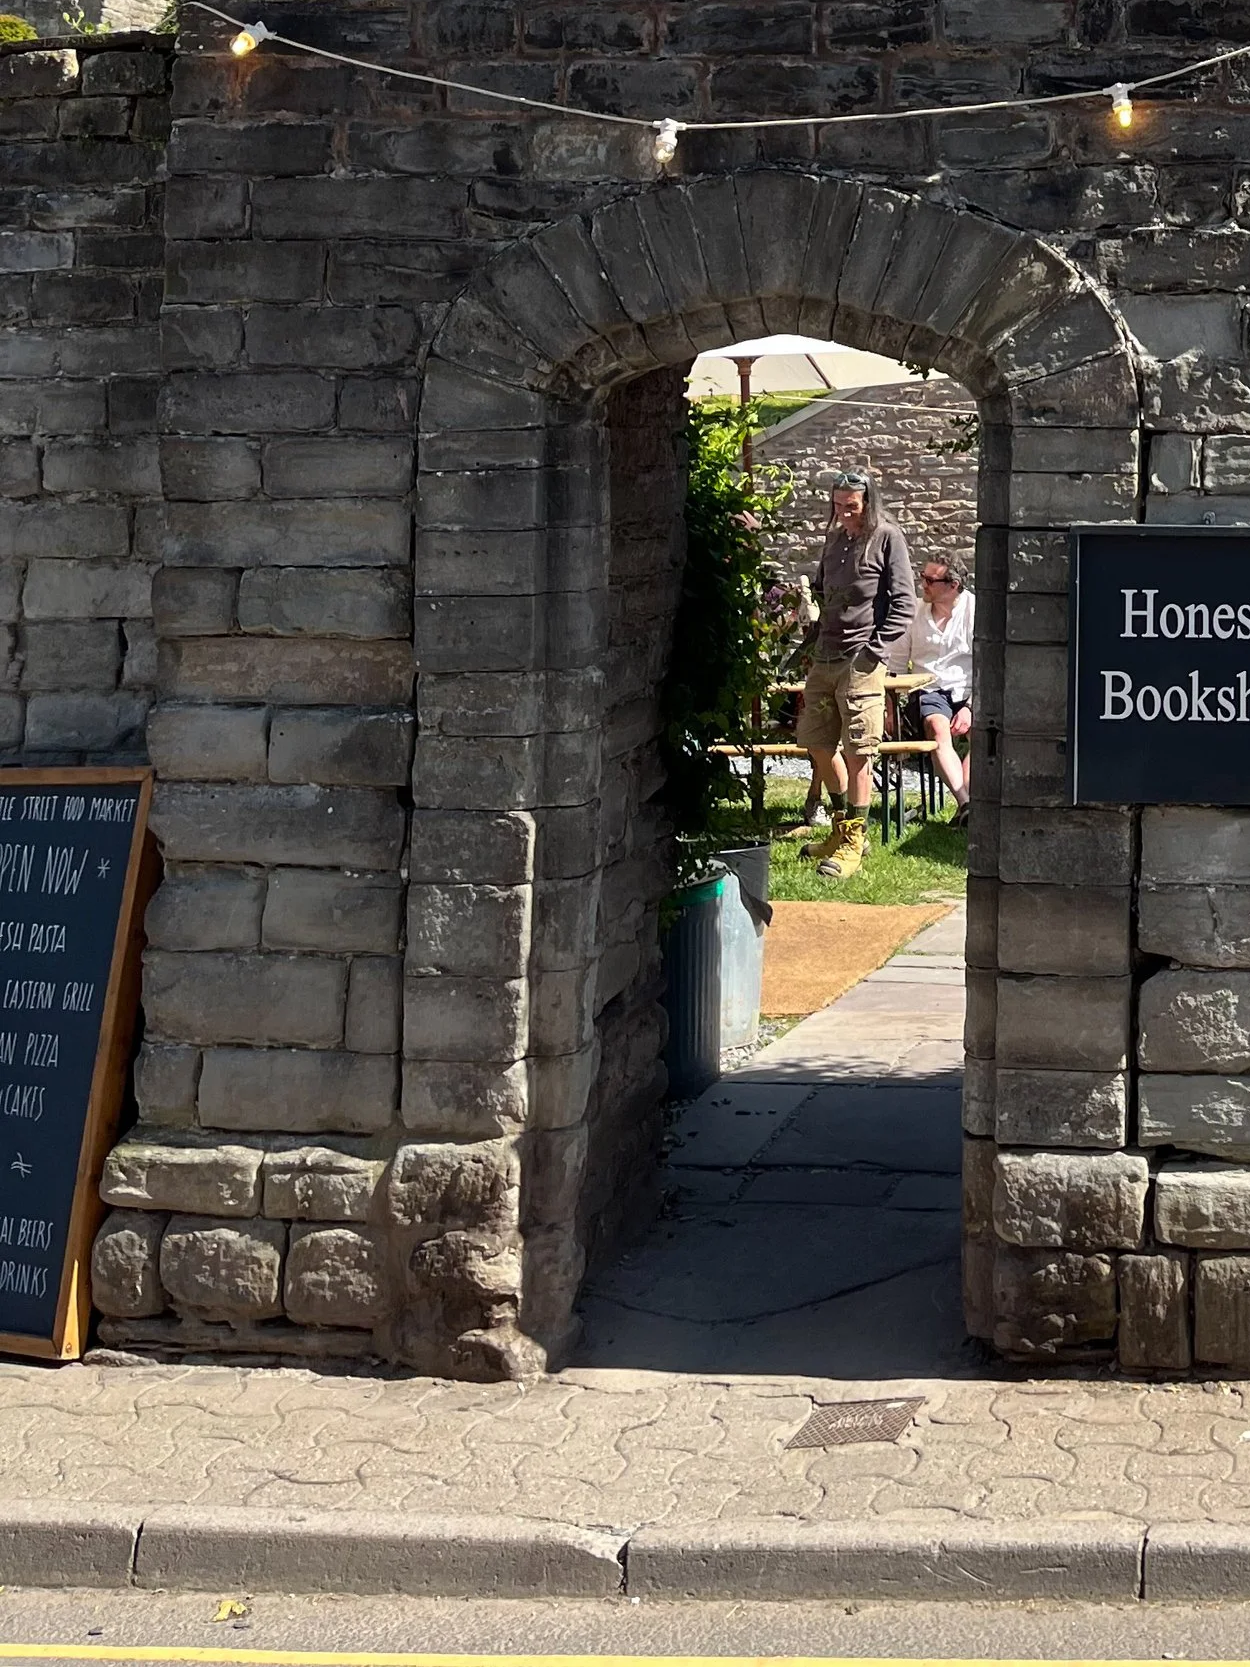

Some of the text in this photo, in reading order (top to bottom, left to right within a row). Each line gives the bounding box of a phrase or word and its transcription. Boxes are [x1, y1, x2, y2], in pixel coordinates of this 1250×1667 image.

[20, 796, 59, 821] STREET
[63, 796, 86, 822] FOOD
[89, 797, 136, 822] MARKET
[41, 845, 89, 895] NOW
[28, 923, 66, 953] PASTA
[3, 979, 94, 1012] EASTERN GRILL
[24, 1032, 59, 1068] PIZZA
[4, 1084, 45, 1122] CAKES
[17, 1218, 54, 1252] BEERS
